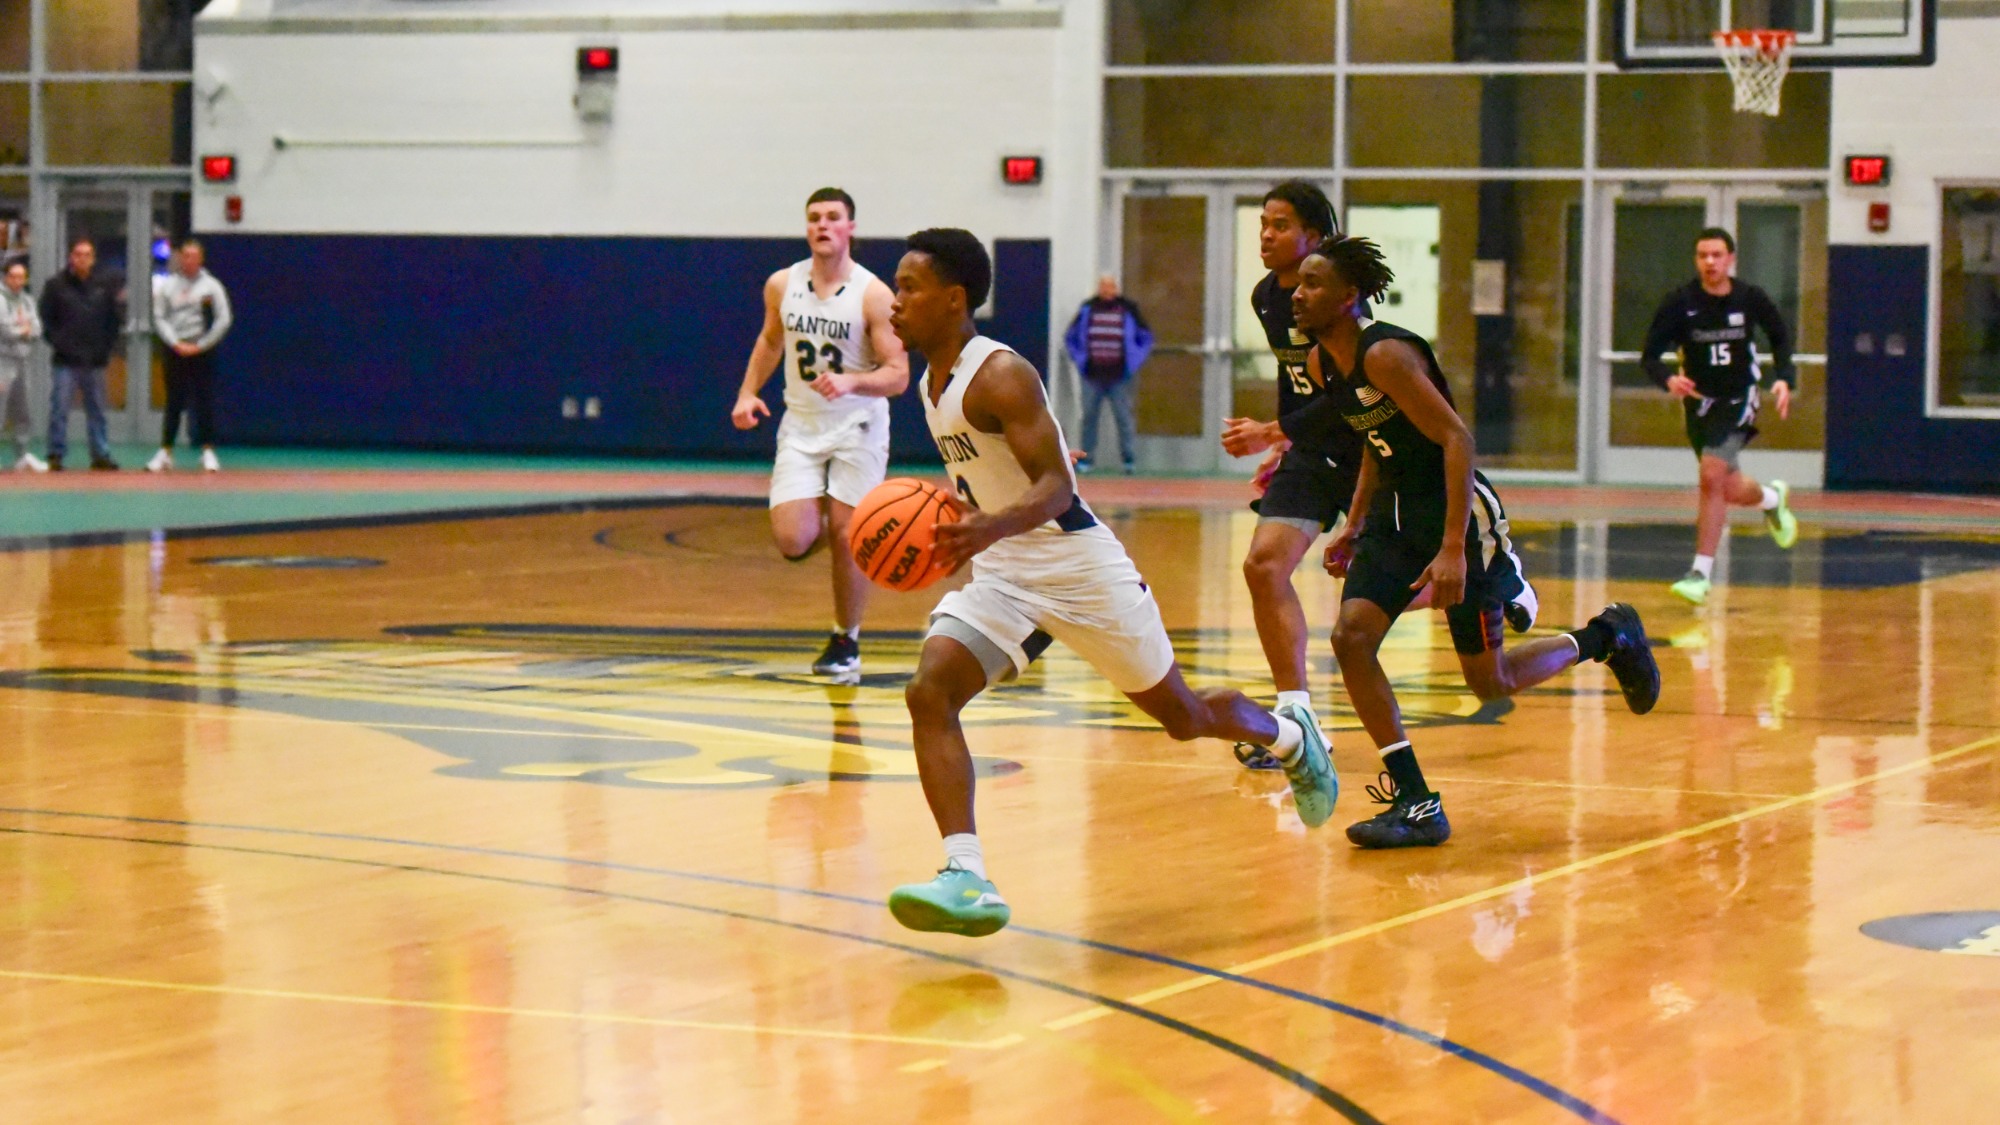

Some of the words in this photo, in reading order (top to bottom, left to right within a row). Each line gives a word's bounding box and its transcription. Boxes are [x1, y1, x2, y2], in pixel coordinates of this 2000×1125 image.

[786, 313, 851, 340] CANTON
[796, 340, 843, 381] 23
[1711, 343, 1731, 366] 15
[1286, 364, 1313, 395] 15
[1367, 430, 1393, 457] 5
[855, 517, 901, 572] Wilson
[886, 544, 922, 584] NCAA
